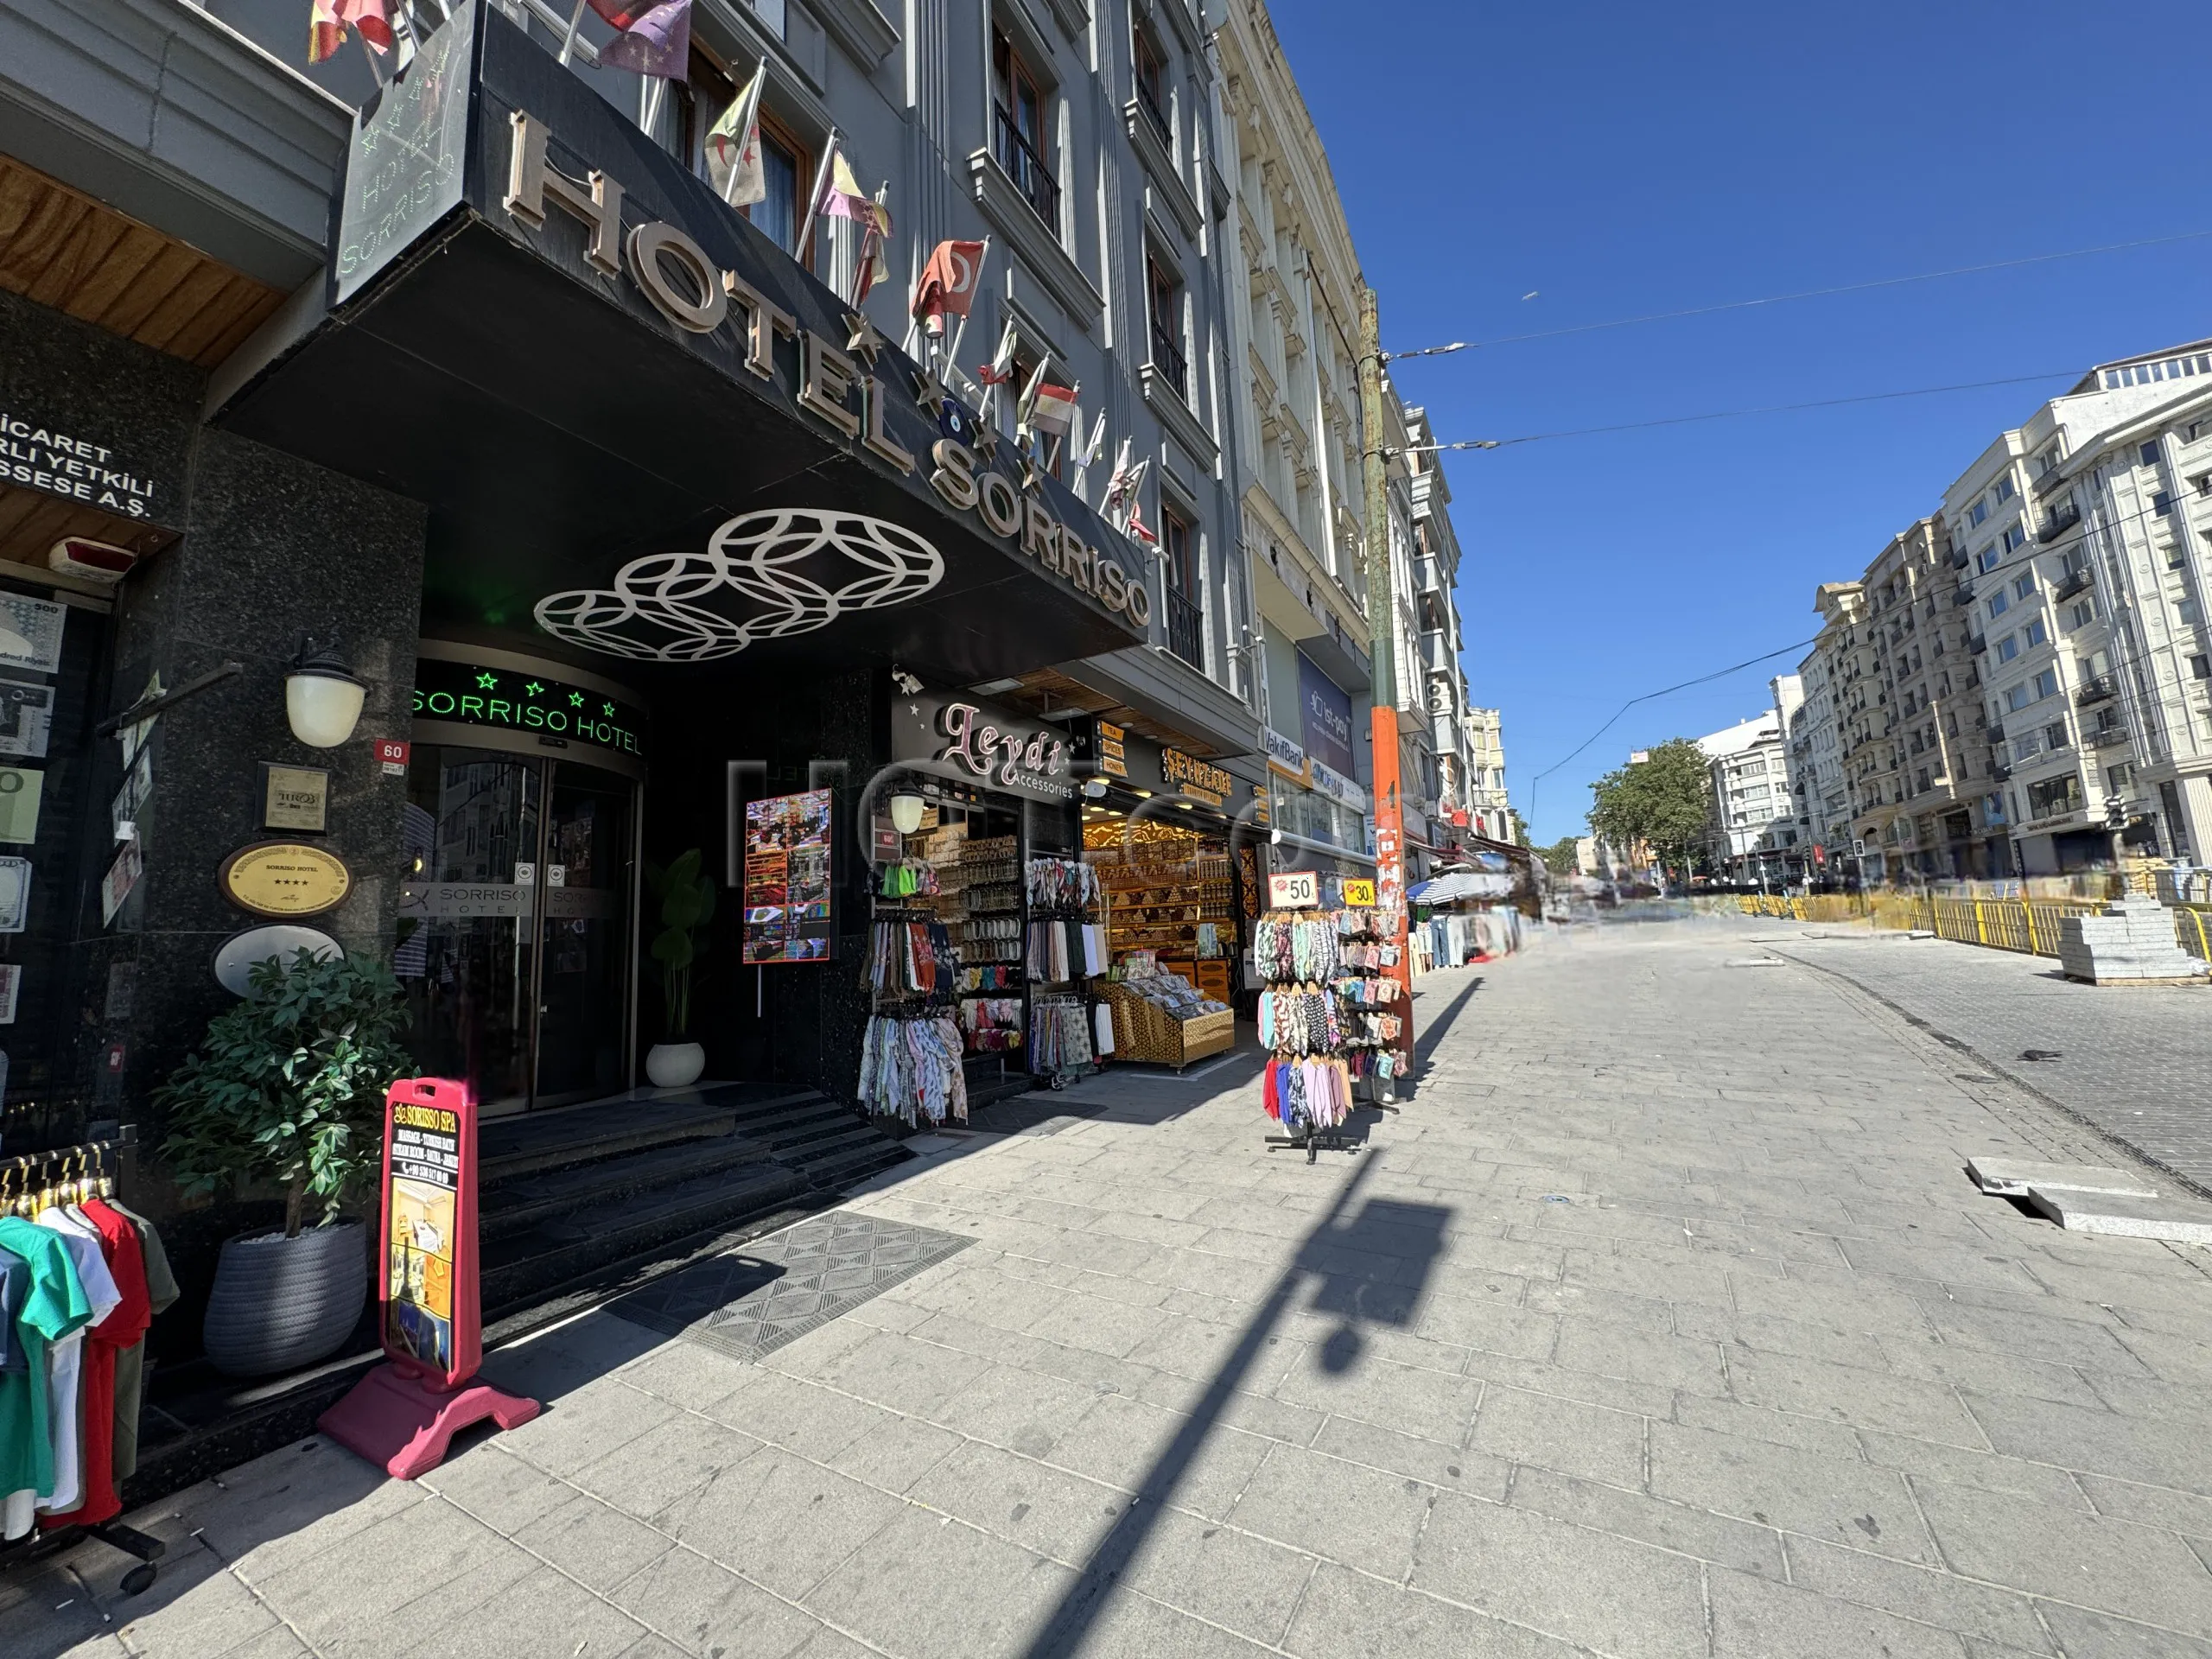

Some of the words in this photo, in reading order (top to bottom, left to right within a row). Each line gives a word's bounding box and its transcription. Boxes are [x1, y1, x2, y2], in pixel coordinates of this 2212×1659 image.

[340, 153, 454, 274] SORRISO
[503, 109, 915, 477] HOTEL
[930, 438, 1152, 629] SORRISO
[46, 452, 154, 498] YETKİLİ
[98, 491, 151, 518] A.Ş.
[35, 602, 59, 615] 500
[411, 690, 568, 731] SORRISO
[578, 716, 643, 755] HOTEL
[1106, 725, 1117, 736] TEA
[384, 744, 403, 759] 60
[942, 702, 1062, 785] Leydi
[1103, 741, 1122, 755] SPICES
[1105, 760, 1122, 772] HONEY
[1014, 769, 1073, 799] Accessories
[440, 888, 526, 900] SORRISO
[1290, 879, 1310, 899] 50
[1356, 886, 1369, 901] 30
[407, 1105, 440, 1130] SORISSO
[441, 1110, 456, 1133] SPA
